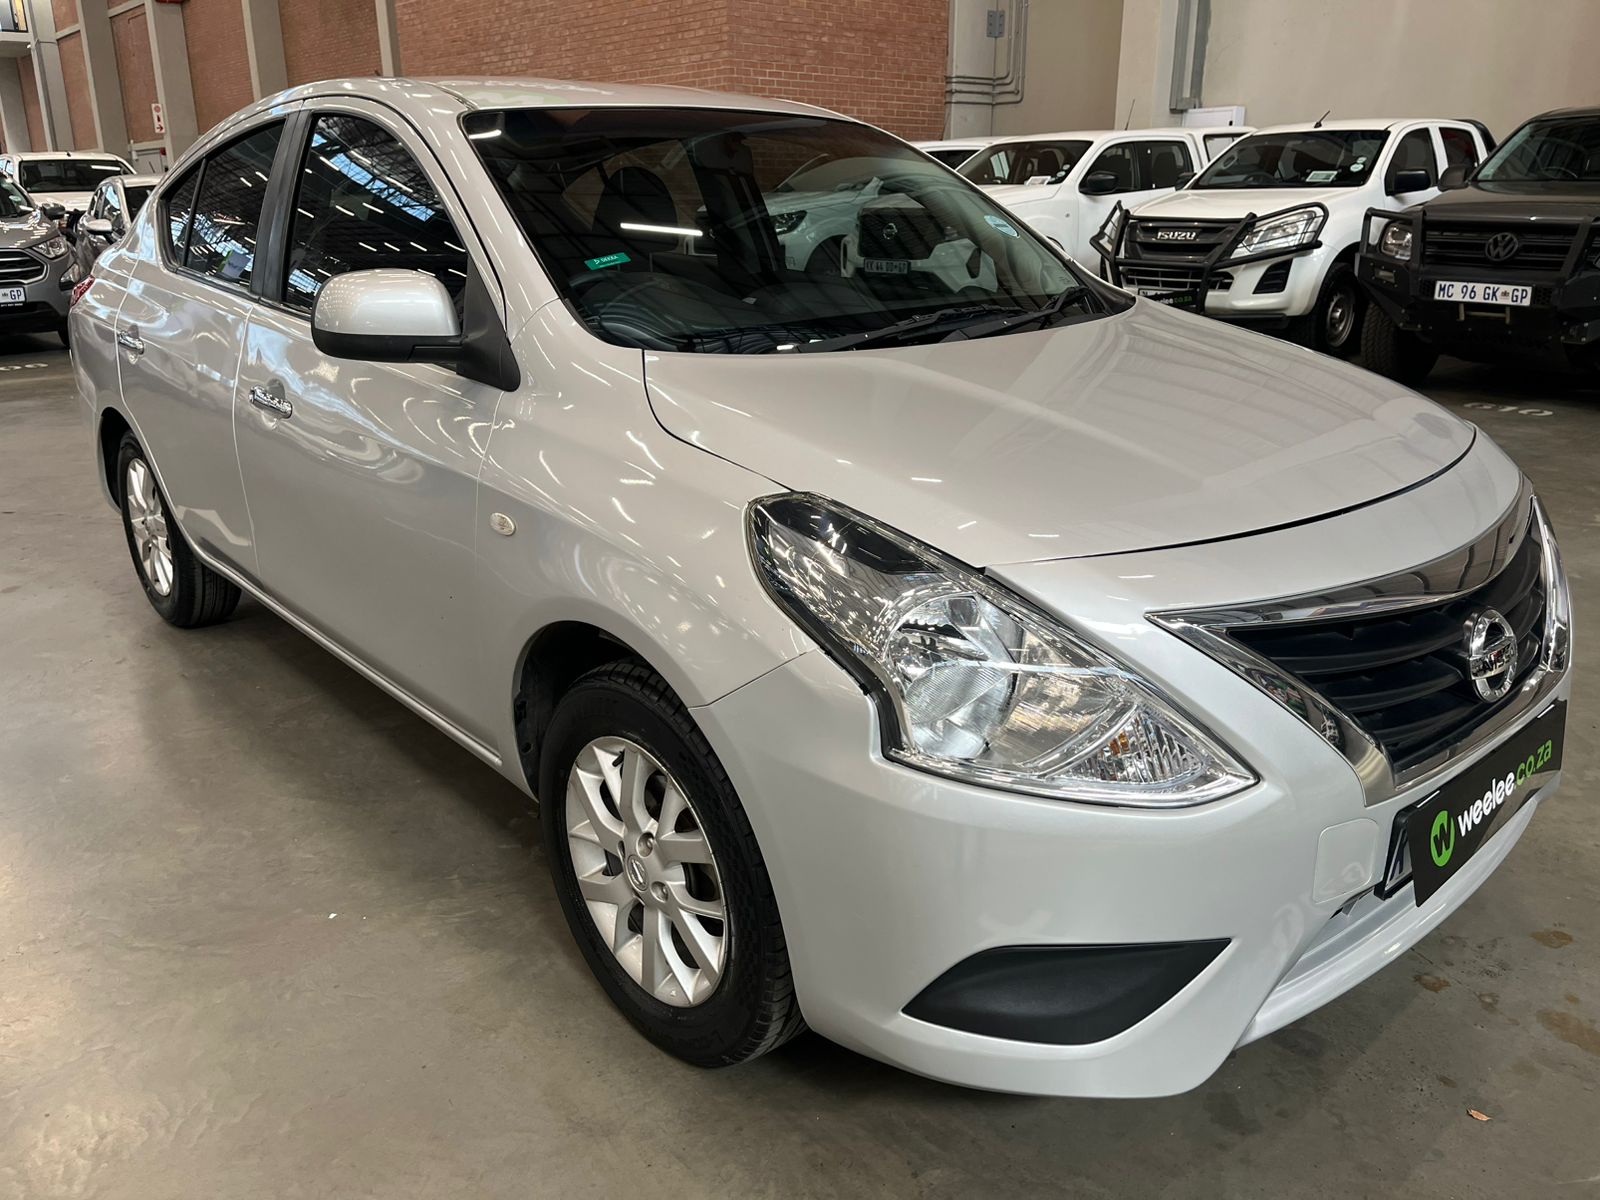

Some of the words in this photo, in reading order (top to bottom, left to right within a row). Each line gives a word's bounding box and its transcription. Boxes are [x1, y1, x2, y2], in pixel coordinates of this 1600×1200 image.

[1157, 231, 1196, 240] ISUZU
[9, 289, 22, 301] GP
[1438, 284, 1454, 298] MC
[1461, 285, 1477, 300] 96
[1483, 287, 1500, 302] GK
[1511, 289, 1528, 304] GP
[1457, 739, 1552, 837] weelee.co.za
